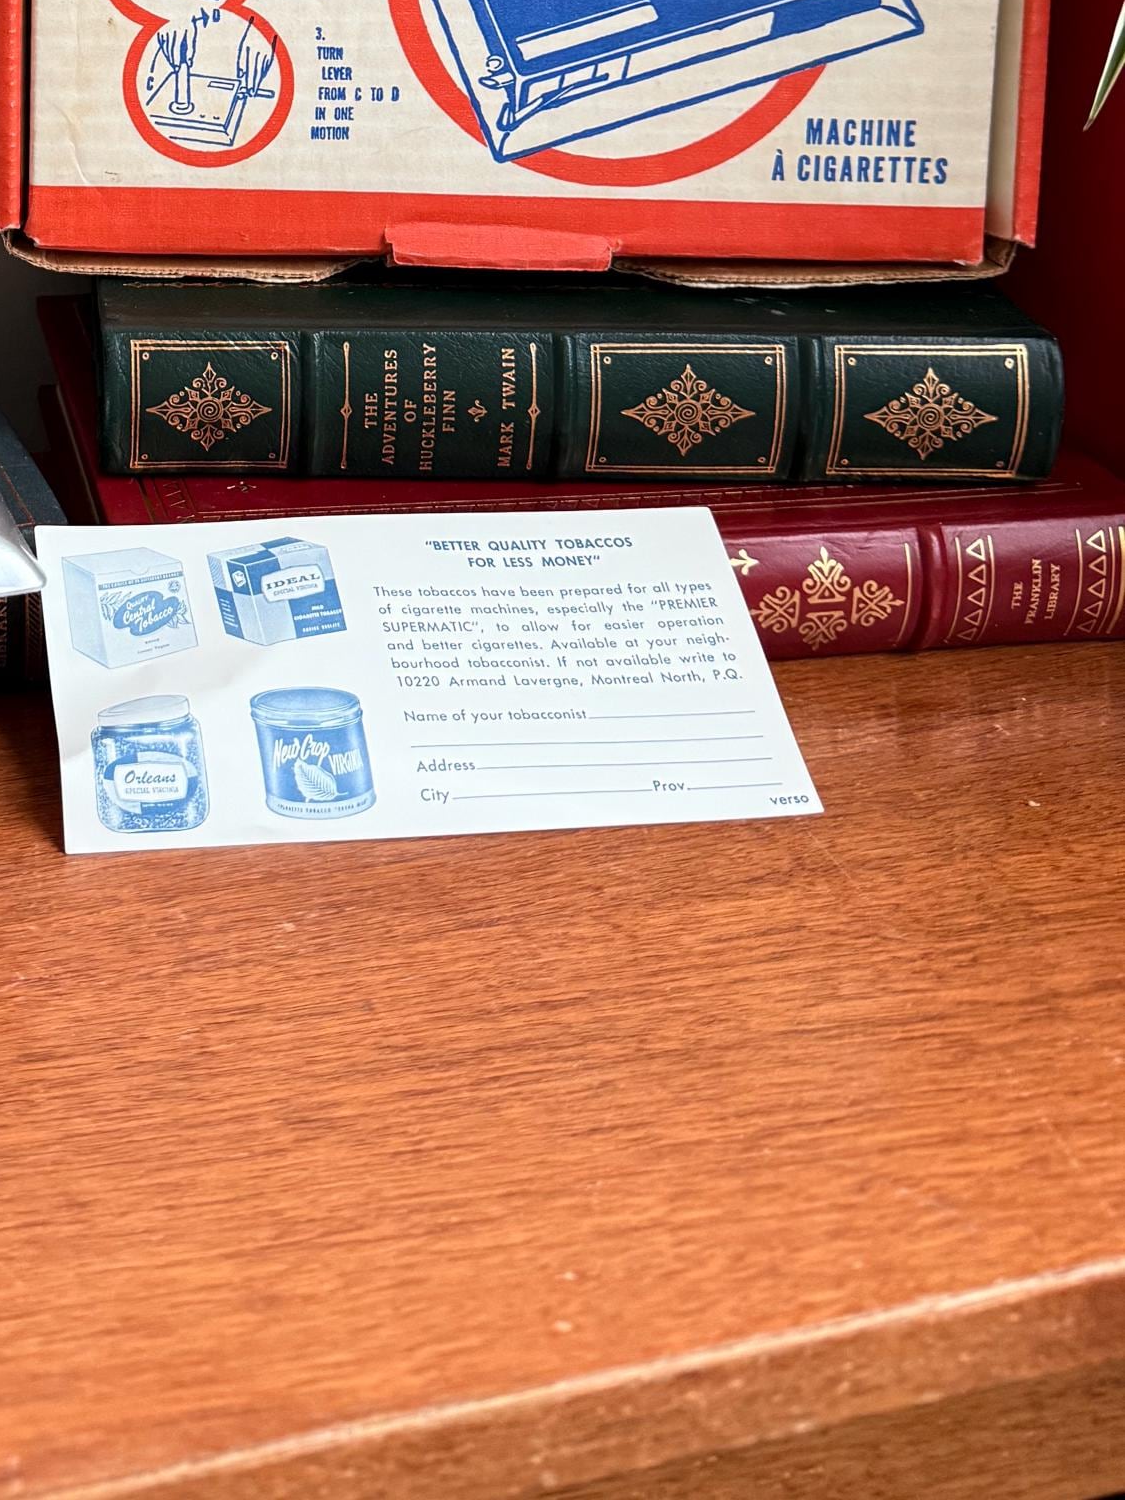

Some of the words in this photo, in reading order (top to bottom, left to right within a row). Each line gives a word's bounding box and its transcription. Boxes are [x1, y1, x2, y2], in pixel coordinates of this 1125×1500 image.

[315, 26, 326, 41] 3.
[317, 46, 344, 61] TURN
[321, 66, 353, 81] LEVER
[318, 87, 347, 101] FROM
[371, 87, 384, 101] TO
[391, 87, 401, 102] D
[315, 106, 326, 121] IN
[334, 106, 355, 121] ONE
[310, 126, 350, 141] MOTION
[805, 118, 917, 148] MACHINE
[770, 149, 786, 182] À
[797, 155, 948, 185] CIGARETTES
[501, 347, 516, 410] TWAIN
[364, 392, 378, 429] THE
[381, 349, 398, 465] ADVENTURES
[403, 399, 417, 423] OF
[419, 343, 437, 471] HUCKLEBERRY
[442, 390, 456, 433] FINN
[497, 421, 515, 467] MARK
[425, 540, 481, 552] "BETTER
[488, 539, 547, 553] QUALITY
[555, 536, 633, 550] TOBACCOS
[467, 556, 496, 568] FOR
[503, 556, 534, 568] LESS
[541, 554, 601, 567] MONEY"
[266, 573, 321, 590] IDEAL
[373, 585, 413, 597] These
[418, 585, 477, 597] tobaccos
[481, 586, 516, 597] have
[519, 585, 554, 597] been
[559, 583, 623, 599] prepared
[627, 582, 647, 595] for
[652, 581, 671, 593] all
[675, 581, 712, 595] types
[1024, 558, 1042, 624] FRANKLIN
[1010, 581, 1024, 610] THE
[1044, 563, 1061, 620] LIBRARY
[123, 598, 156, 625] Central
[378, 603, 392, 615] of
[401, 604, 462, 617] cigarette
[470, 603, 539, 617] machines,
[547, 601, 614, 617] especially
[622, 601, 644, 612] the
[650, 597, 719, 611] "PREMIER
[135, 606, 174, 632] Tobacco
[496, 622, 510, 632] to
[521, 620, 560, 632] allow
[571, 619, 592, 631] for
[604, 618, 645, 630] easier
[657, 615, 724, 631] operation
[387, 639, 414, 651] and
[421, 639, 463, 651] better
[471, 639, 544, 653] cigarettes.
[550, 637, 618, 649] Available
[625, 637, 639, 648] at
[646, 636, 678, 650] your
[391, 656, 460, 669] bourhood
[467, 656, 551, 669] tobacconist.
[557, 655, 568, 668] If
[576, 656, 598, 668] not
[605, 653, 672, 667] available
[679, 651, 716, 665] write
[723, 651, 737, 662] to
[396, 675, 440, 688] 10220
[449, 674, 507, 687] Armand
[513, 674, 584, 689] Lavergne,
[591, 671, 654, 686] Montreal
[660, 670, 706, 684] North,
[712, 667, 743, 681] P.Q.
[403, 710, 448, 722] Name
[452, 708, 466, 721] of
[470, 710, 503, 724] your
[508, 708, 587, 721] tobacconist
[300, 733, 331, 768] Crop
[328, 748, 364, 776] VIRGINIA
[416, 757, 476, 773] Address
[124, 769, 177, 784] Orleans
[420, 787, 450, 804] City
[769, 793, 810, 806] verso
